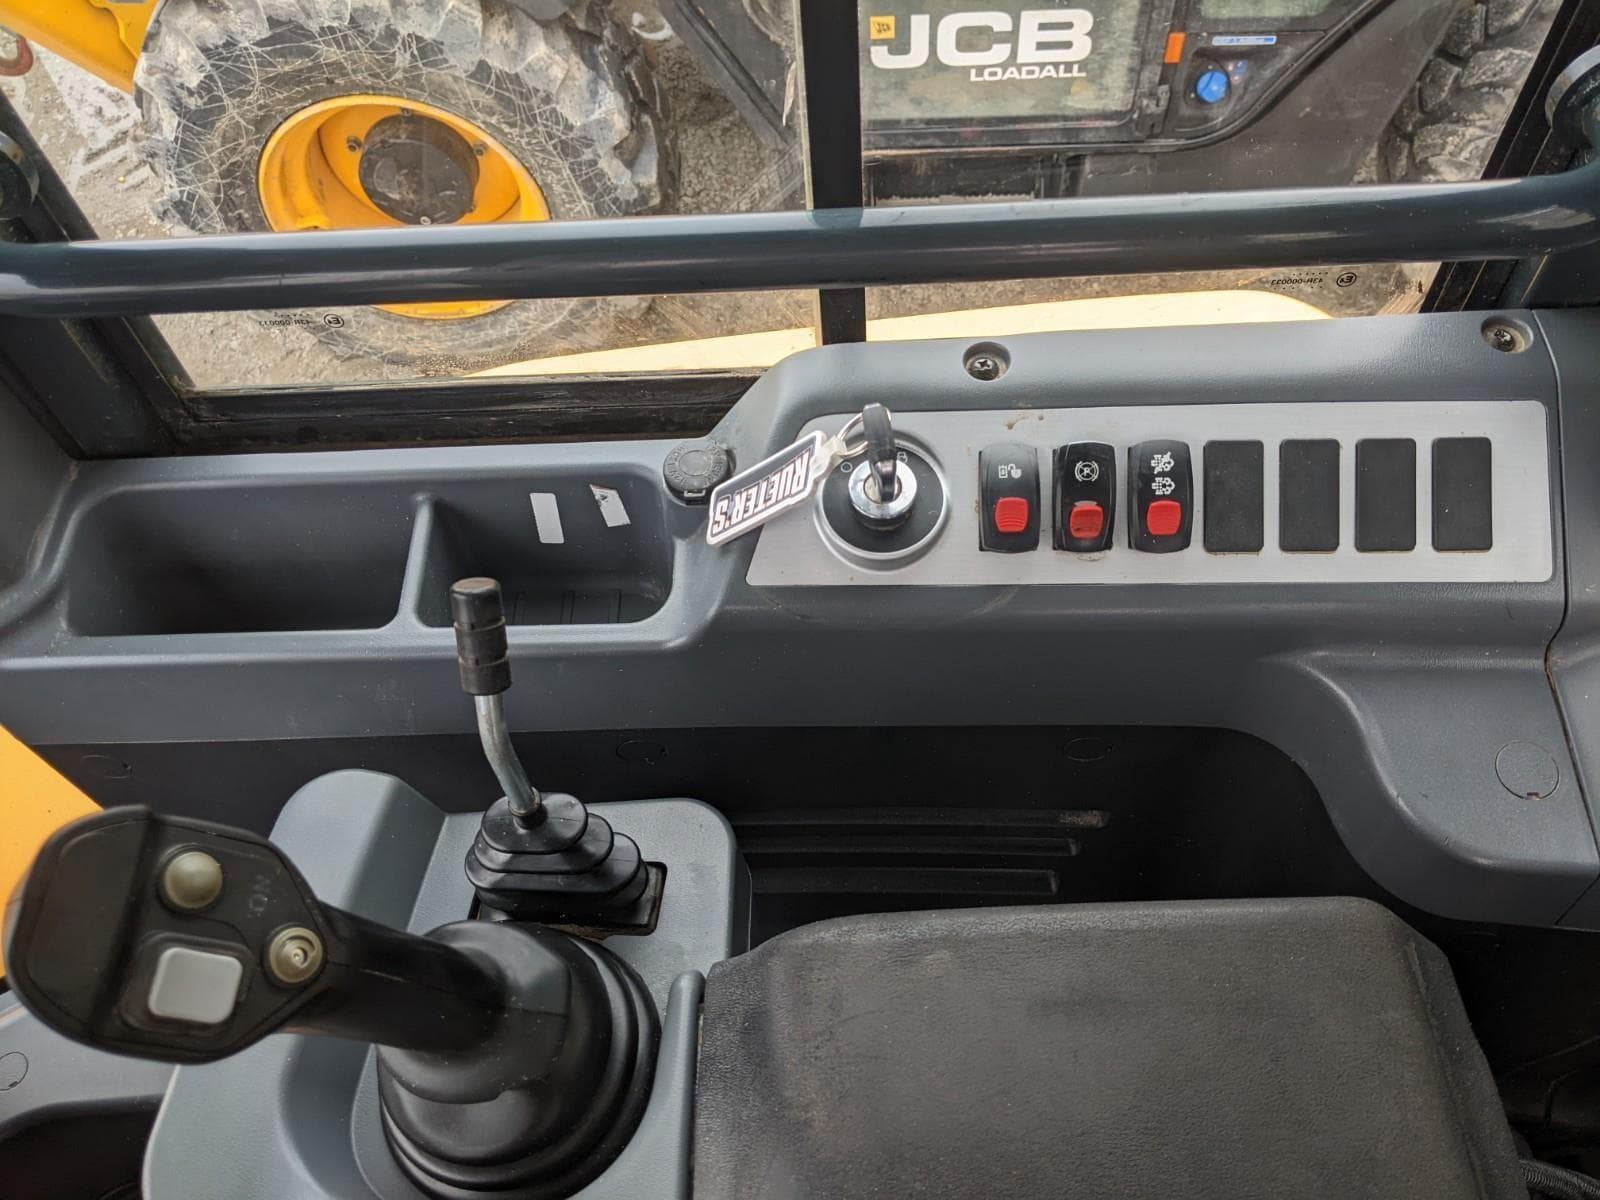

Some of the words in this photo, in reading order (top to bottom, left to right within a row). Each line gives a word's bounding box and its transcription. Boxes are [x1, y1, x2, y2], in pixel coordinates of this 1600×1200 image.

[870, 9, 1094, 69] JCB
[970, 64, 1087, 81] LOADALL
[712, 450, 811, 535] RUETER'S
